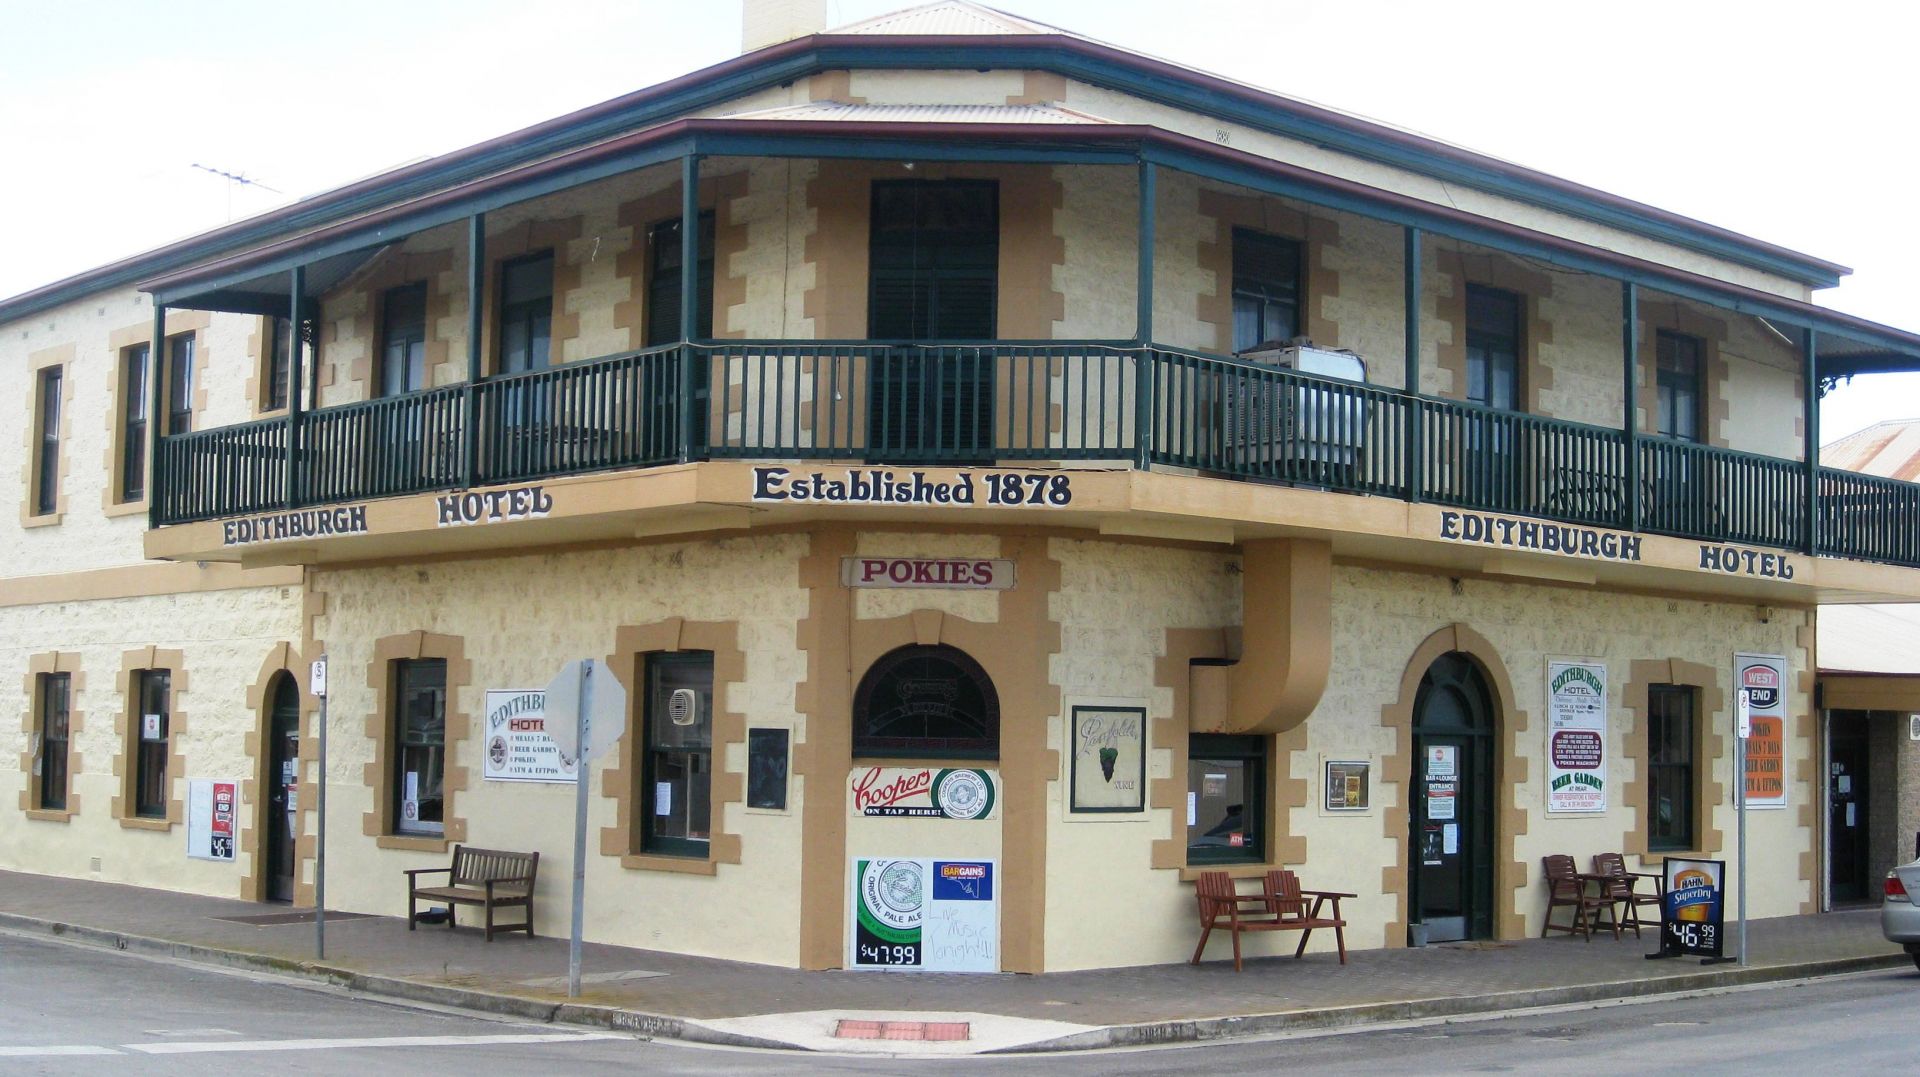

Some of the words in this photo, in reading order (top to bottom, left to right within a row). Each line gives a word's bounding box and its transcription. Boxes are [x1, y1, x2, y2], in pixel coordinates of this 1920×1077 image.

[752, 466, 975, 504] Established
[985, 473, 1072, 506] 1878
[223, 505, 367, 546] EDITHBURGH
[437, 486, 553, 527] HOTEL
[1440, 511, 1643, 561] EDITHBURGH
[1699, 545, 1794, 581] HOTEL
[860, 559, 993, 585] POKIES
[1551, 667, 1603, 697] EDITHBURGH
[1748, 672, 1774, 684] WEST
[1564, 686, 1591, 695] HOTEL
[1751, 689, 1771, 701] END
[490, 693, 546, 729] EDITHB
[510, 719, 544, 731] HOTE
[515, 734, 535, 743] MEALS
[542, 735, 554, 743] DA
[514, 745, 530, 753] BEER
[532, 746, 557, 754] GARDEN
[513, 756, 537, 764] POKIES
[513, 766, 526, 774] ATM
[852, 767, 931, 811] Coopers
[1428, 783, 1454, 791] ENTRANCE
[1551, 773, 1572, 792] BEER
[1574, 772, 1604, 792] GARDEN
[866, 807, 880, 815] ON
[883, 808, 905, 816] TAP
[908, 808, 941, 816] HERE!
[943, 866, 984, 877] BARGAINS
[1681, 877, 1705, 891] HAHN
[867, 876, 882, 913] ORIGINAL
[884, 911, 904, 923] PALE
[907, 912, 922, 923] ALE
[1674, 889, 1712, 905] SuperDry
[861, 944, 915, 965] $47.99
